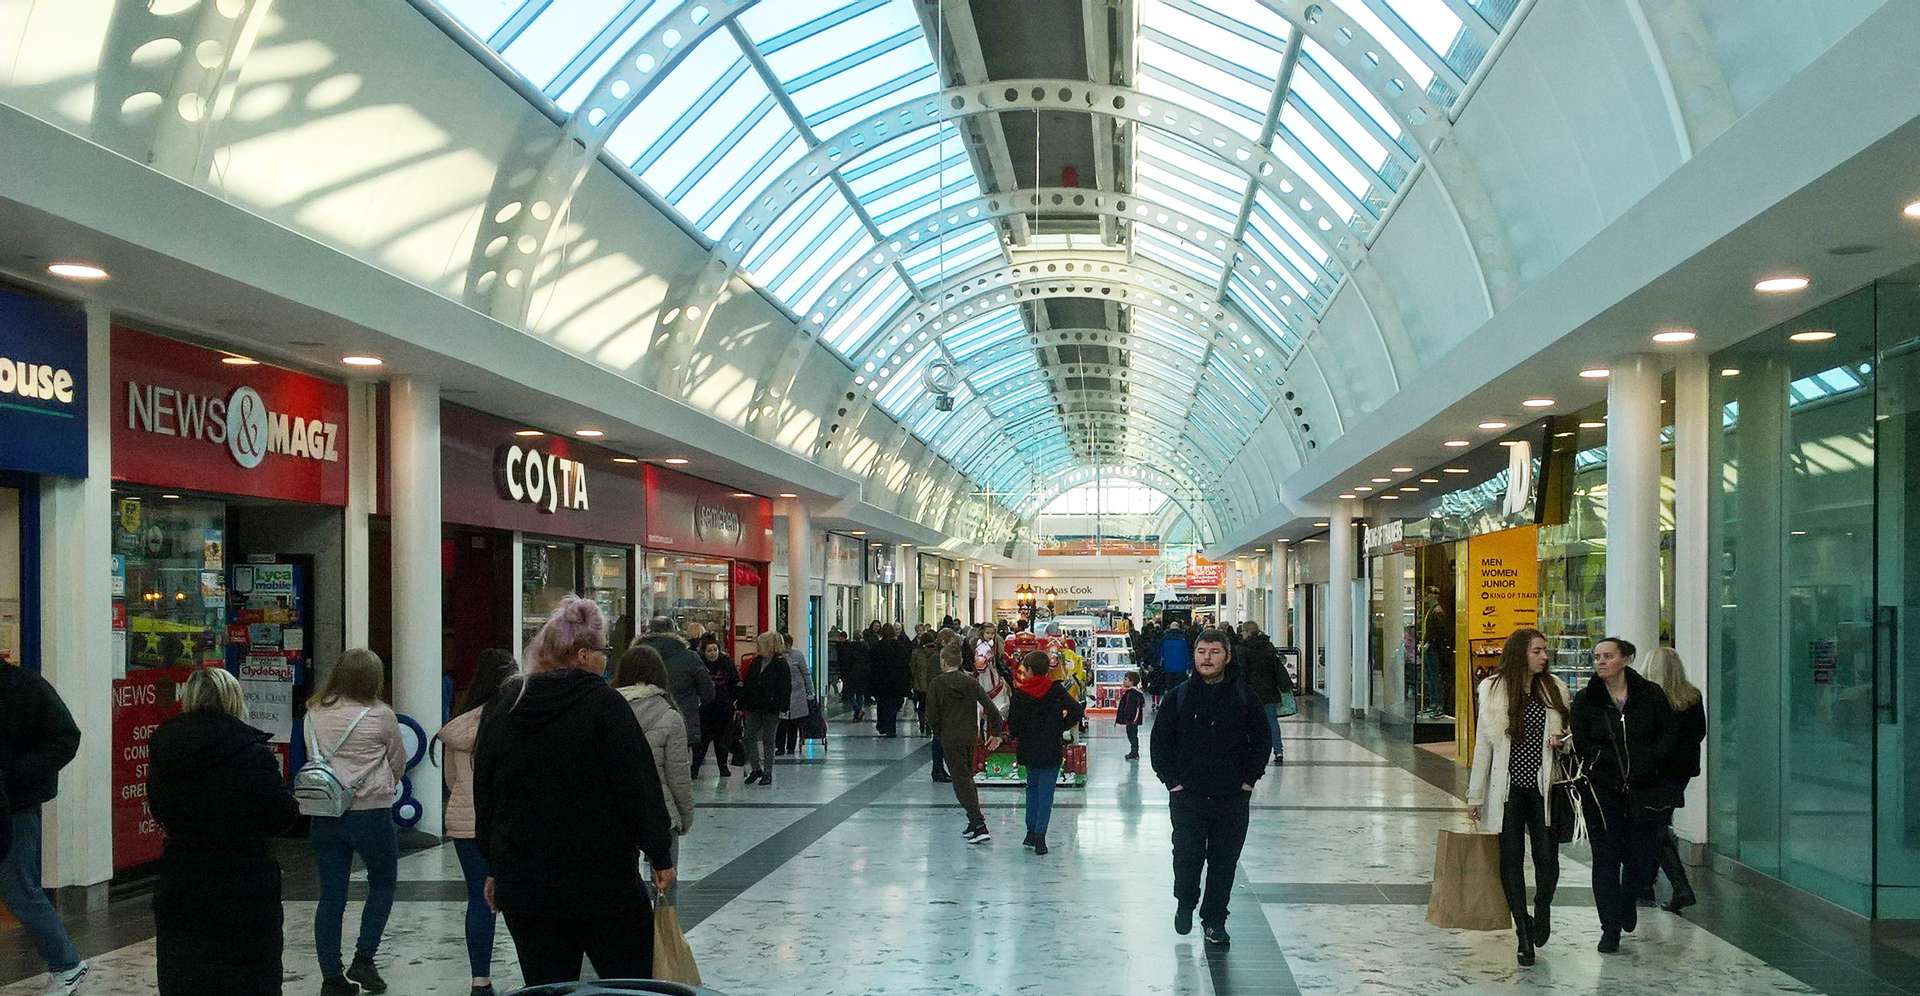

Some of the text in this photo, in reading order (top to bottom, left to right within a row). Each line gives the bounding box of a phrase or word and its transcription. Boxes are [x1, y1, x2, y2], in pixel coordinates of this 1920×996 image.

[128, 381, 226, 443] NEWS
[267, 411, 338, 462] MAGZ
[506, 445, 589, 513] COSTA
[1481, 558, 1503, 567] MEN
[256, 568, 291, 581] Lyca
[1481, 569, 1518, 577] WOMEN
[256, 581, 291, 590] mobile
[1481, 580, 1516, 588] JUNIOR
[1034, 585, 1093, 594] Thoas Cook
[241, 666, 293, 677] Clydebank
[112, 683, 156, 707] NEWS
